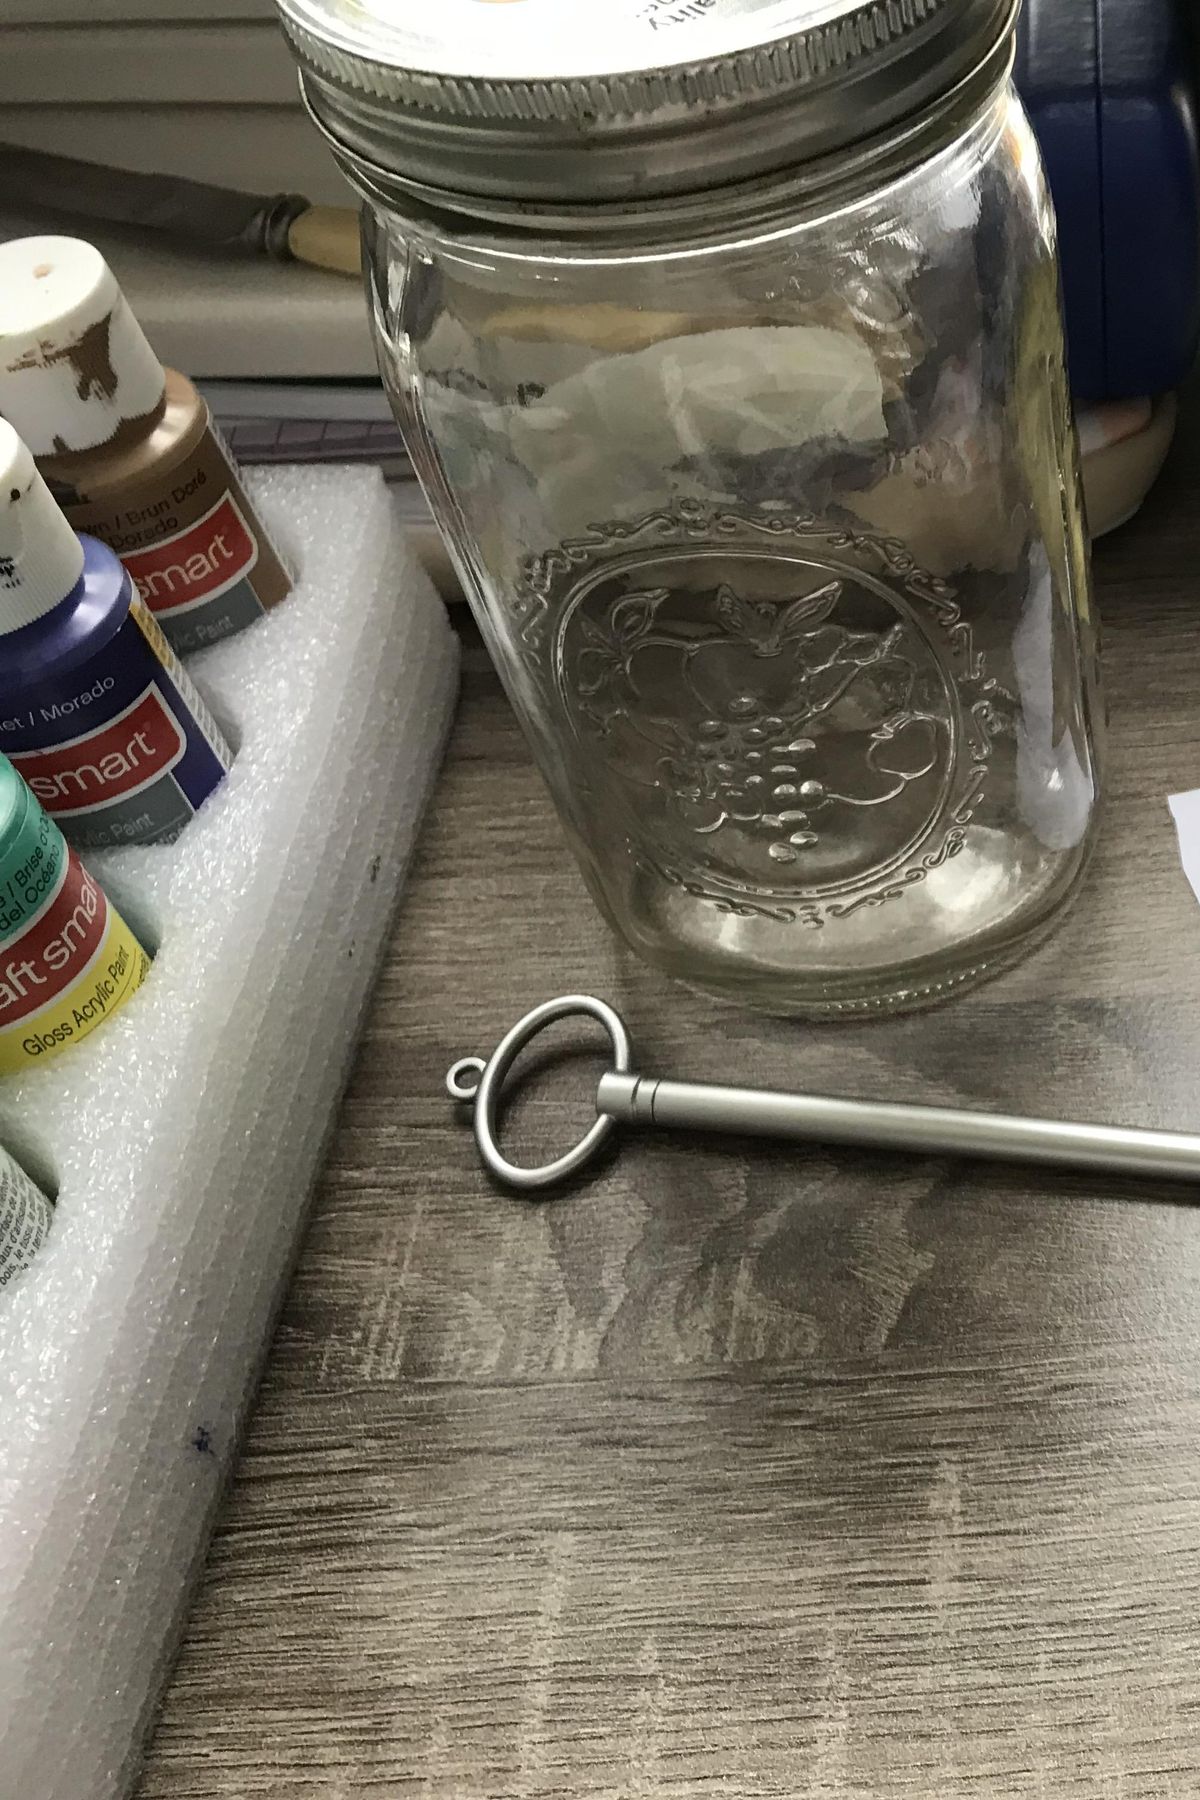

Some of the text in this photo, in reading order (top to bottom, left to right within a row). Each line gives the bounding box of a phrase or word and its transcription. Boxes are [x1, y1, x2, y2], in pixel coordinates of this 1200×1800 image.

[125, 499, 170, 526] Brun
[132, 534, 234, 600] smart
[39, 675, 115, 723] Morado
[29, 731, 157, 799] smart
[110, 812, 155, 840] Paint
[14, 846, 44, 887] Brise
[0, 900, 26, 931] del
[0, 957, 48, 1009] aft
[22, 944, 130, 1057] Gloss Acrylic Paint
